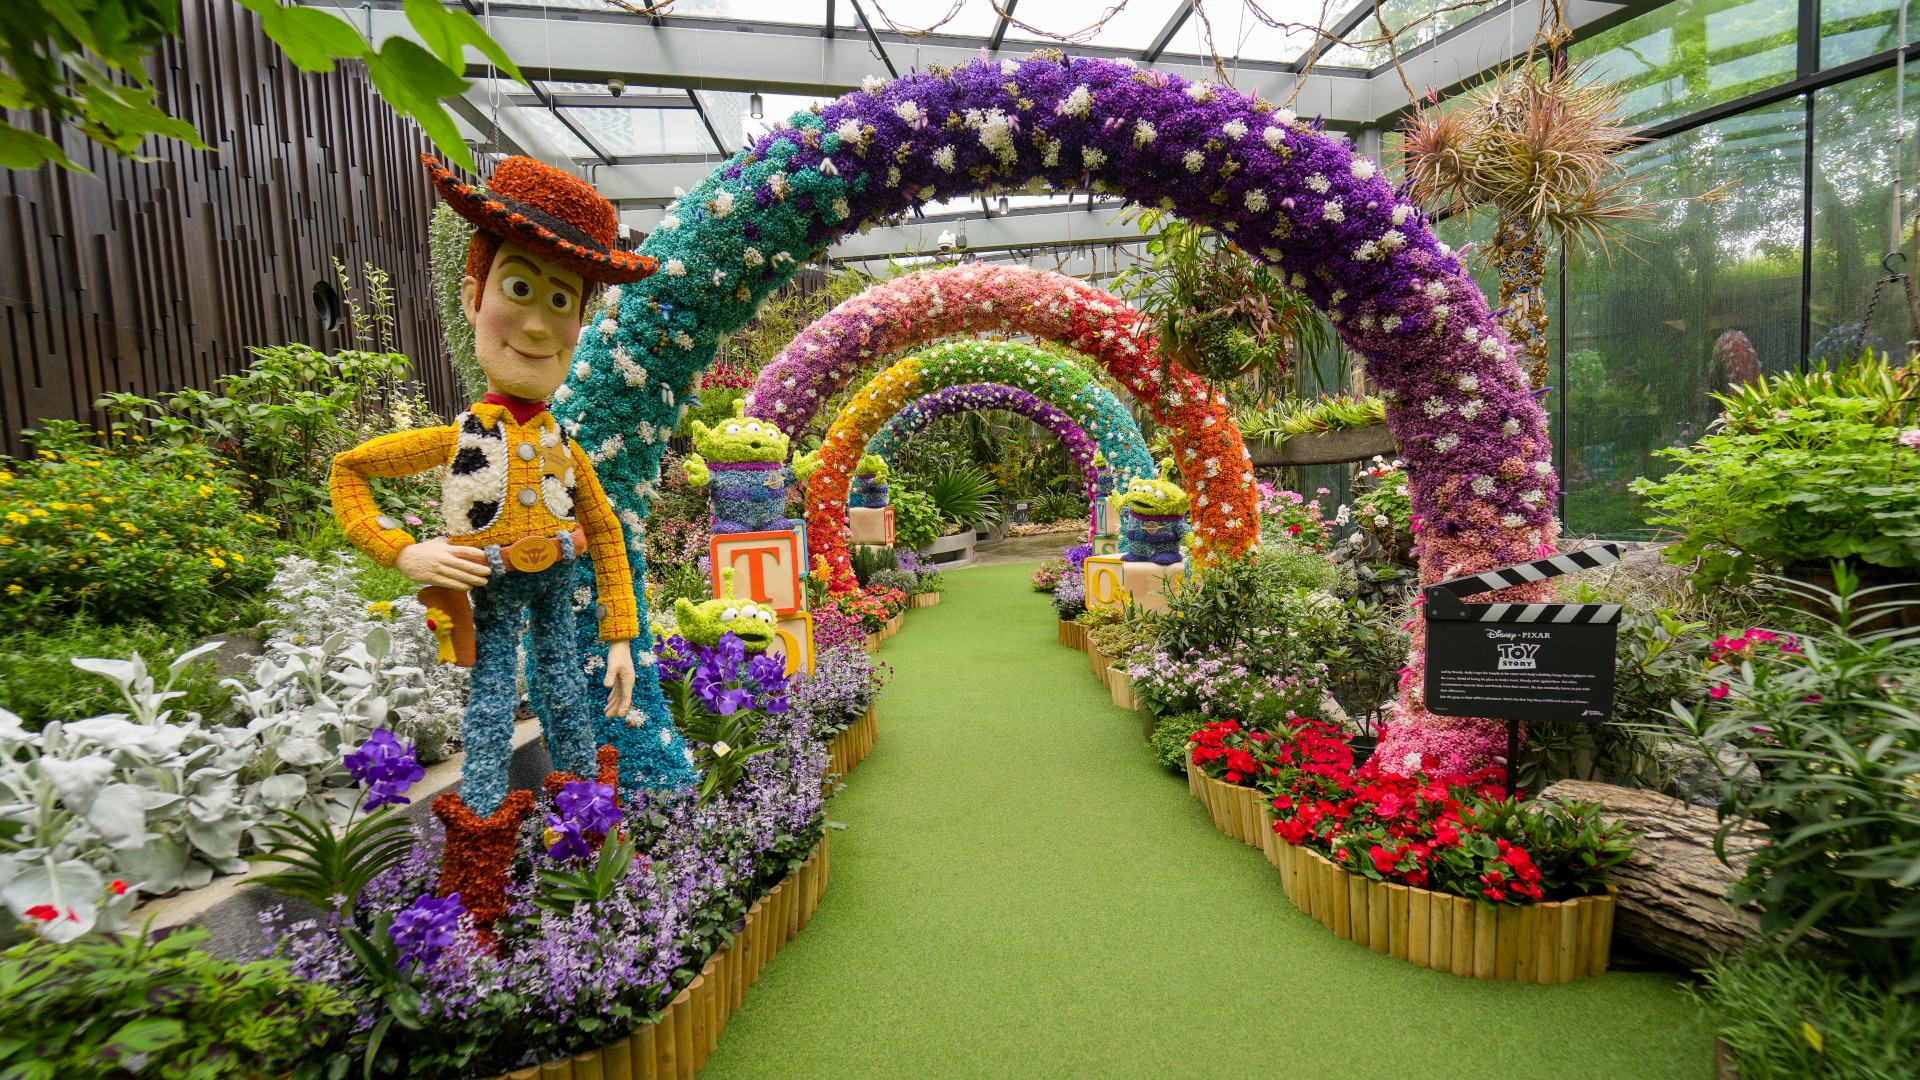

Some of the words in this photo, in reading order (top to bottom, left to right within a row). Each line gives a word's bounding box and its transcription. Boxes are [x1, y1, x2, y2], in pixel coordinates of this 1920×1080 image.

[730, 546, 780, 602] T
[1092, 568, 1118, 604] O
[1485, 628, 1517, 641] Disney
[1497, 643, 1541, 660] TOY
